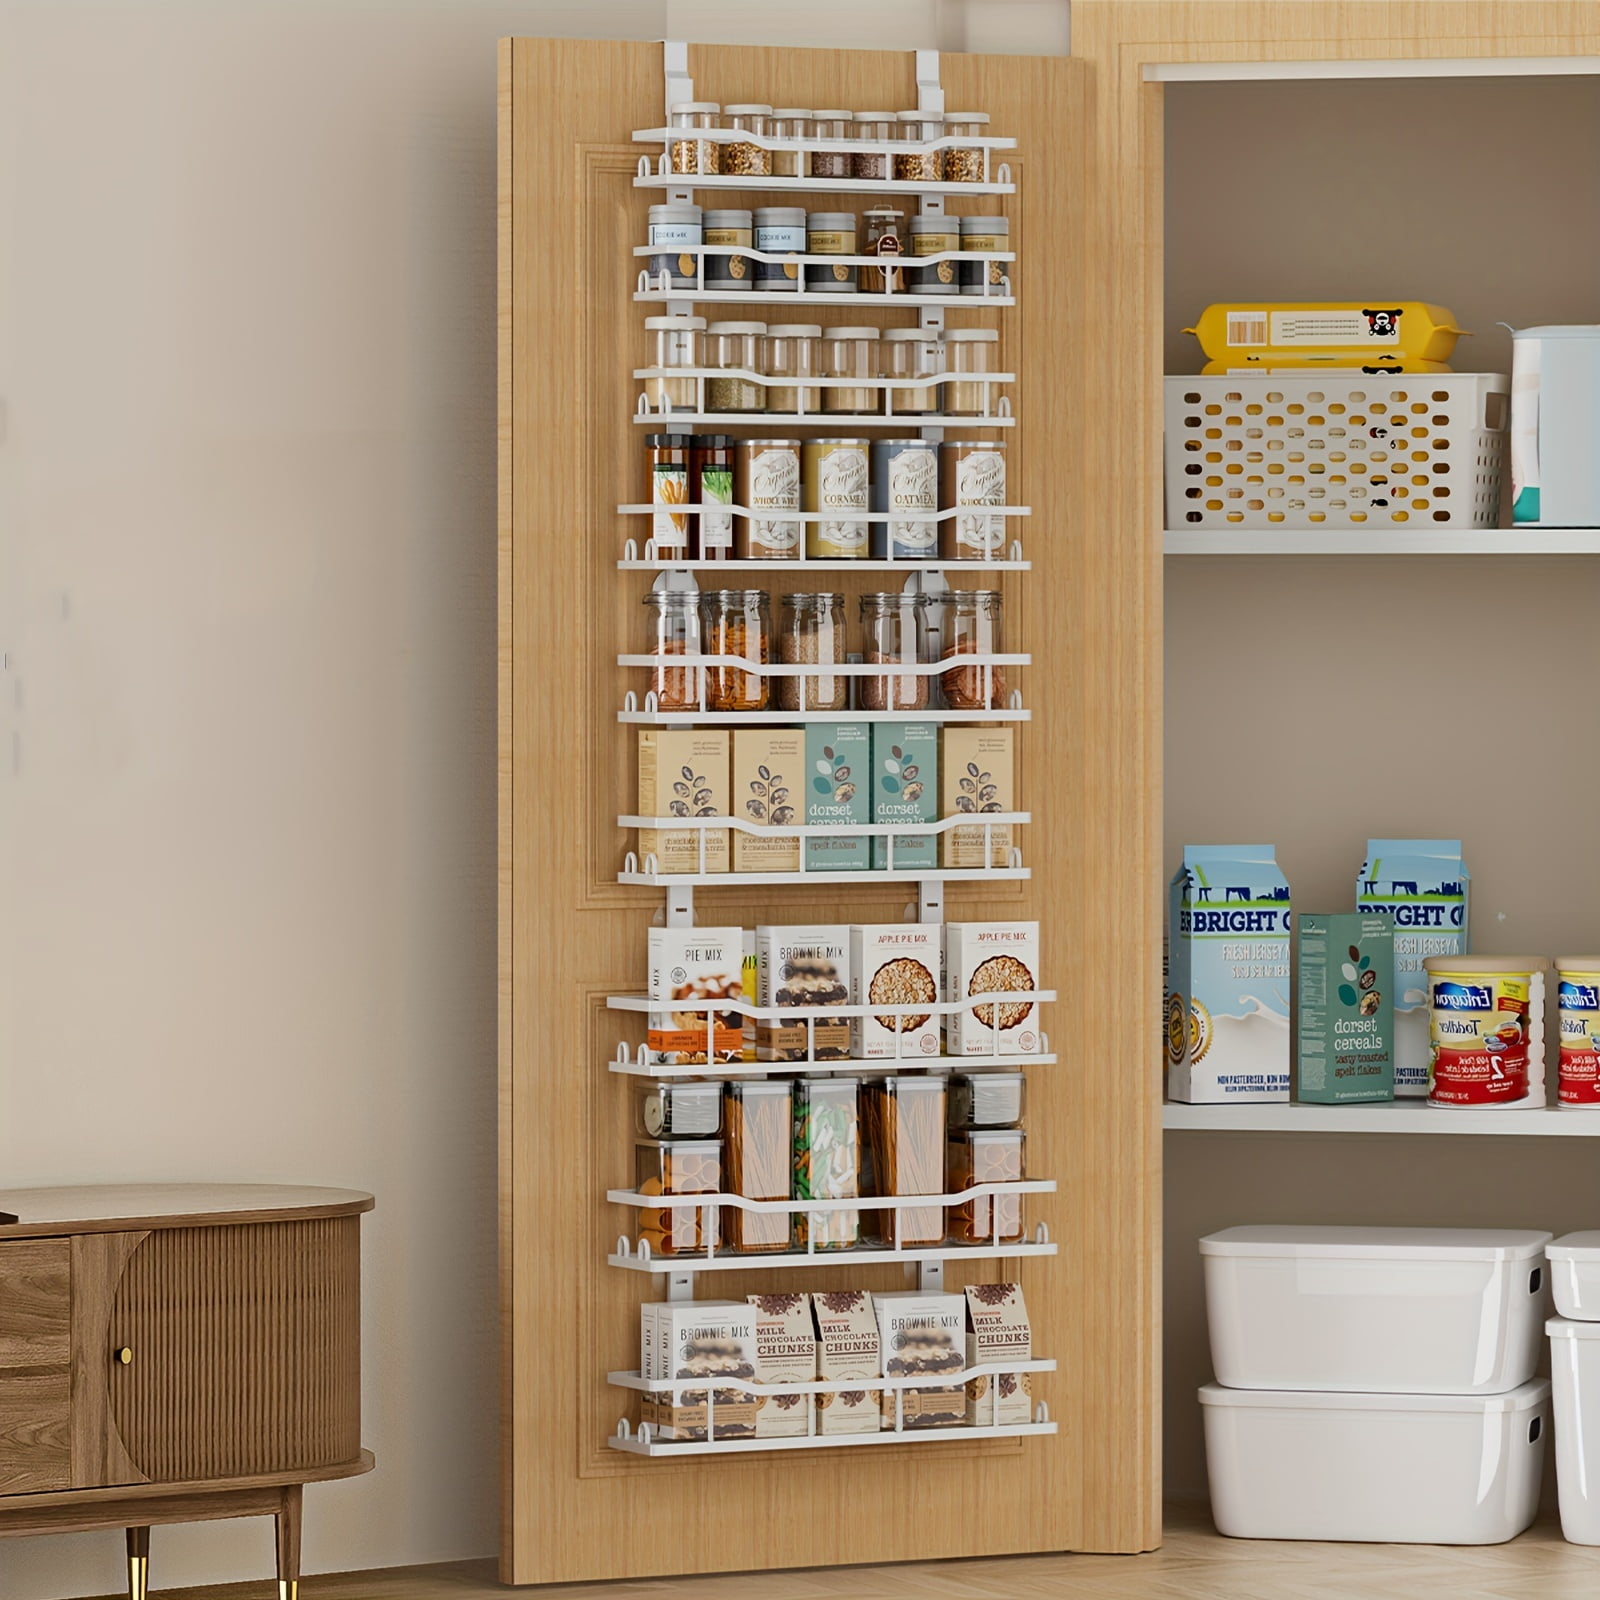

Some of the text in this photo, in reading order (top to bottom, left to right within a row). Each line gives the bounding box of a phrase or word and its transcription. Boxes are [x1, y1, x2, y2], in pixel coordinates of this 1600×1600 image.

[809, 803, 853, 816] dorset
[877, 802, 921, 815] dorset
[1193, 910, 1278, 932] BRIGHT
[878, 935, 899, 944] APPLE
[977, 933, 998, 942] APPLE
[1222, 943, 1283, 961] FRESH JERSEY
[1418, 938, 1450, 954] JERSEY
[685, 949, 723, 962] PIE MIX
[779, 946, 844, 960] BROWNIE MIX
[1334, 1018, 1378, 1034] dorset
[1334, 1034, 1383, 1051] cereals
[891, 1316, 959, 1330] BROWNIE MIX
[975, 1316, 1003, 1325] MILK
[680, 1325, 750, 1341] BROWNIE MIX
[756, 1327, 786, 1336] MILK
[823, 1324, 851, 1333] MILK
[976, 1325, 1029, 1334] CHOCOLATE
[756, 1335, 814, 1344] CHOCOLATE
[825, 1332, 878, 1341] CHOCOLATE
[977, 1333, 1030, 1344] CHUNKS
[757, 1344, 814, 1354] CHUNKS
[825, 1341, 878, 1352] CHUNKS
